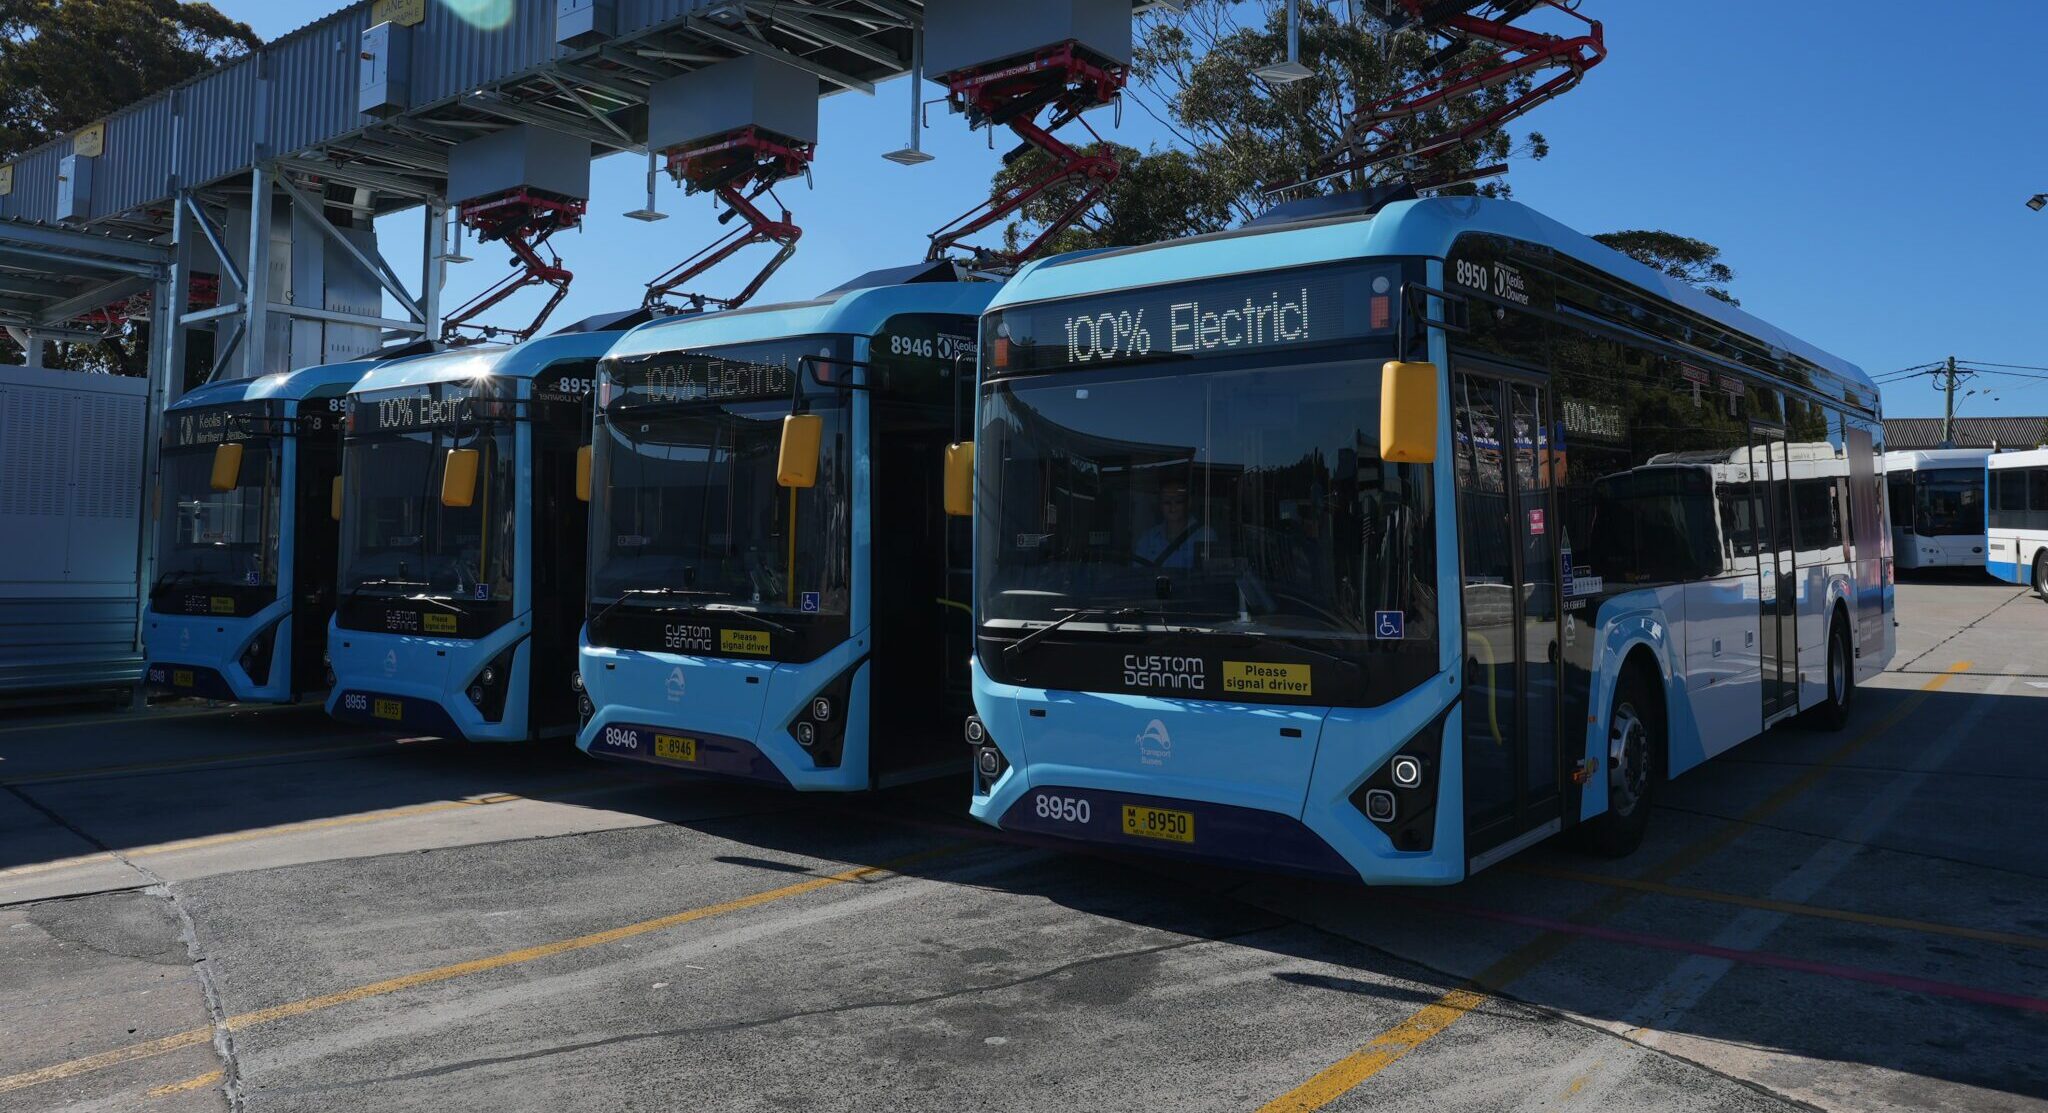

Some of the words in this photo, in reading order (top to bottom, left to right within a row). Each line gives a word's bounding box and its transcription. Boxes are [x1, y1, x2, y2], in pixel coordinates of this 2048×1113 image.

[1456, 259, 1488, 291] 8950
[1506, 271, 1524, 290] Keolis
[1506, 286, 1529, 305] Downer
[1065, 309, 1151, 363] 100%
[1170, 288, 1309, 352] Electric!
[891, 335, 933, 357] 8946
[560, 377, 595, 393] 895
[645, 364, 696, 402] 100%
[707, 354, 787, 398] Electric!
[379, 396, 414, 428] 100%
[420, 389, 473, 425] Electr!
[199, 413, 221, 428] Keolis
[665, 623, 712, 638] CUSTOM
[733, 632, 757, 641] Please
[665, 636, 712, 650] DENNING
[722, 641, 745, 651] signal
[746, 643, 769, 651] driver
[1123, 654, 1204, 673] CUSTOM
[1245, 665, 1288, 677] Please
[1123, 671, 1205, 690] DENNING
[1226, 678, 1264, 690] signal
[1269, 679, 1309, 691] driver
[345, 694, 368, 710] 8955
[605, 727, 638, 749] 8946
[669, 738, 692, 756] 8946
[1140, 747, 1171, 758] Transport
[1035, 794, 1091, 824] 8950
[1148, 811, 1186, 834] 8950
